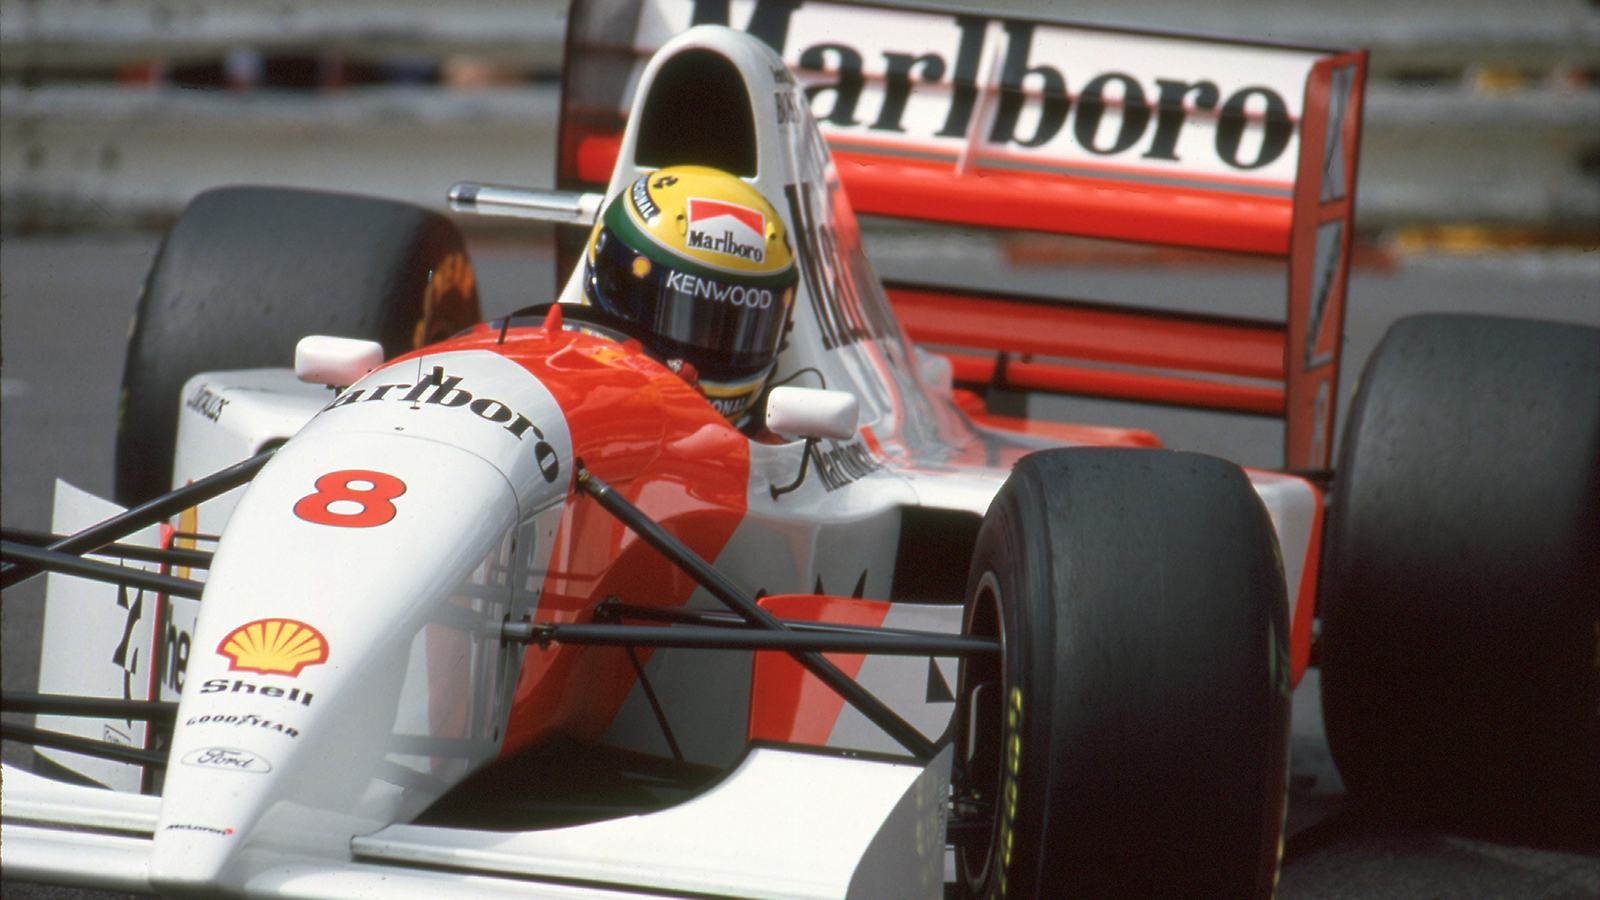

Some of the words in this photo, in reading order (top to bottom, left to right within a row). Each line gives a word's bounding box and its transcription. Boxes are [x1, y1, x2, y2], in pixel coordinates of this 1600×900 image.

[688, 230, 763, 262] Marlboro
[666, 270, 772, 309] KENWOOD
[311, 373, 560, 484] arlboro
[294, 470, 407, 528] 8
[200, 679, 314, 707] Shell
[197, 750, 254, 768] Ford
